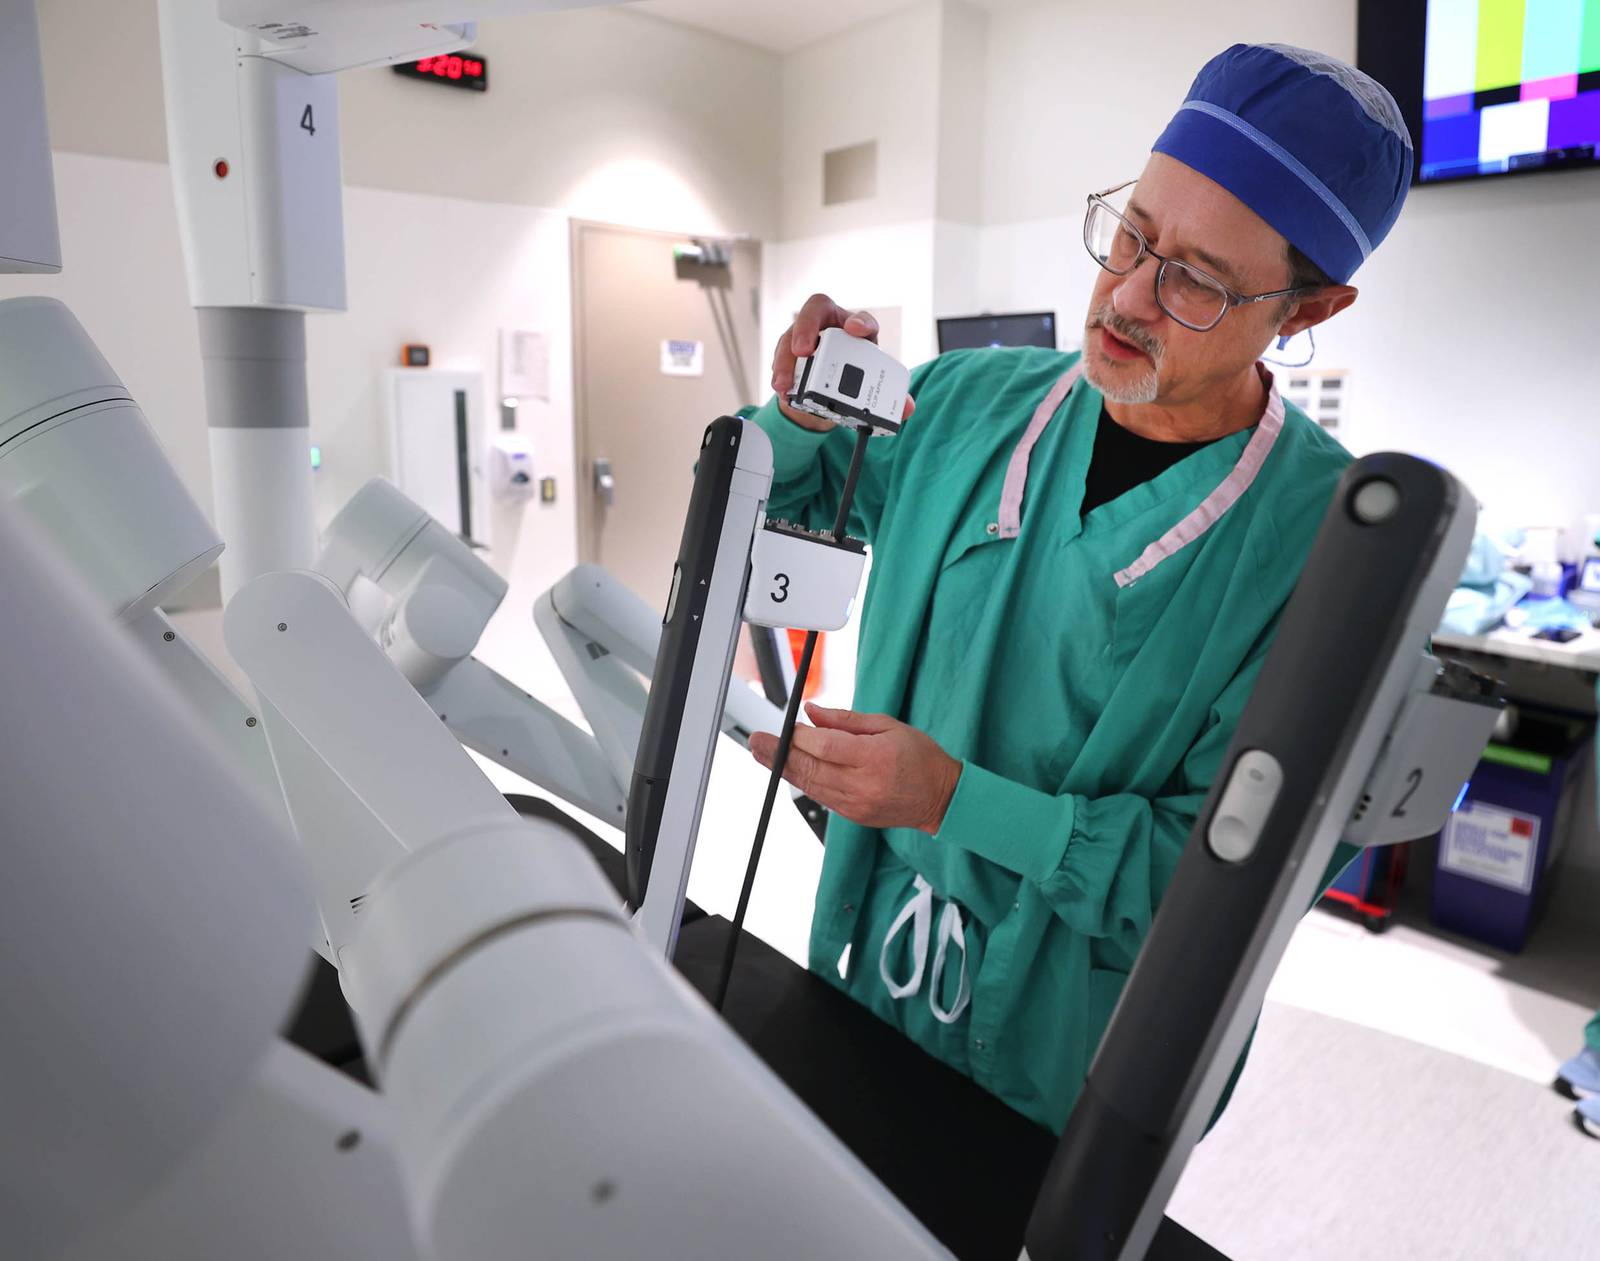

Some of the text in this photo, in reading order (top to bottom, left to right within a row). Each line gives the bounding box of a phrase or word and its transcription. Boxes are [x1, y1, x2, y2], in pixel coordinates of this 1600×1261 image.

[300, 104, 316, 136] 4
[770, 573, 790, 603] 3
[1390, 768, 1423, 818] 2
